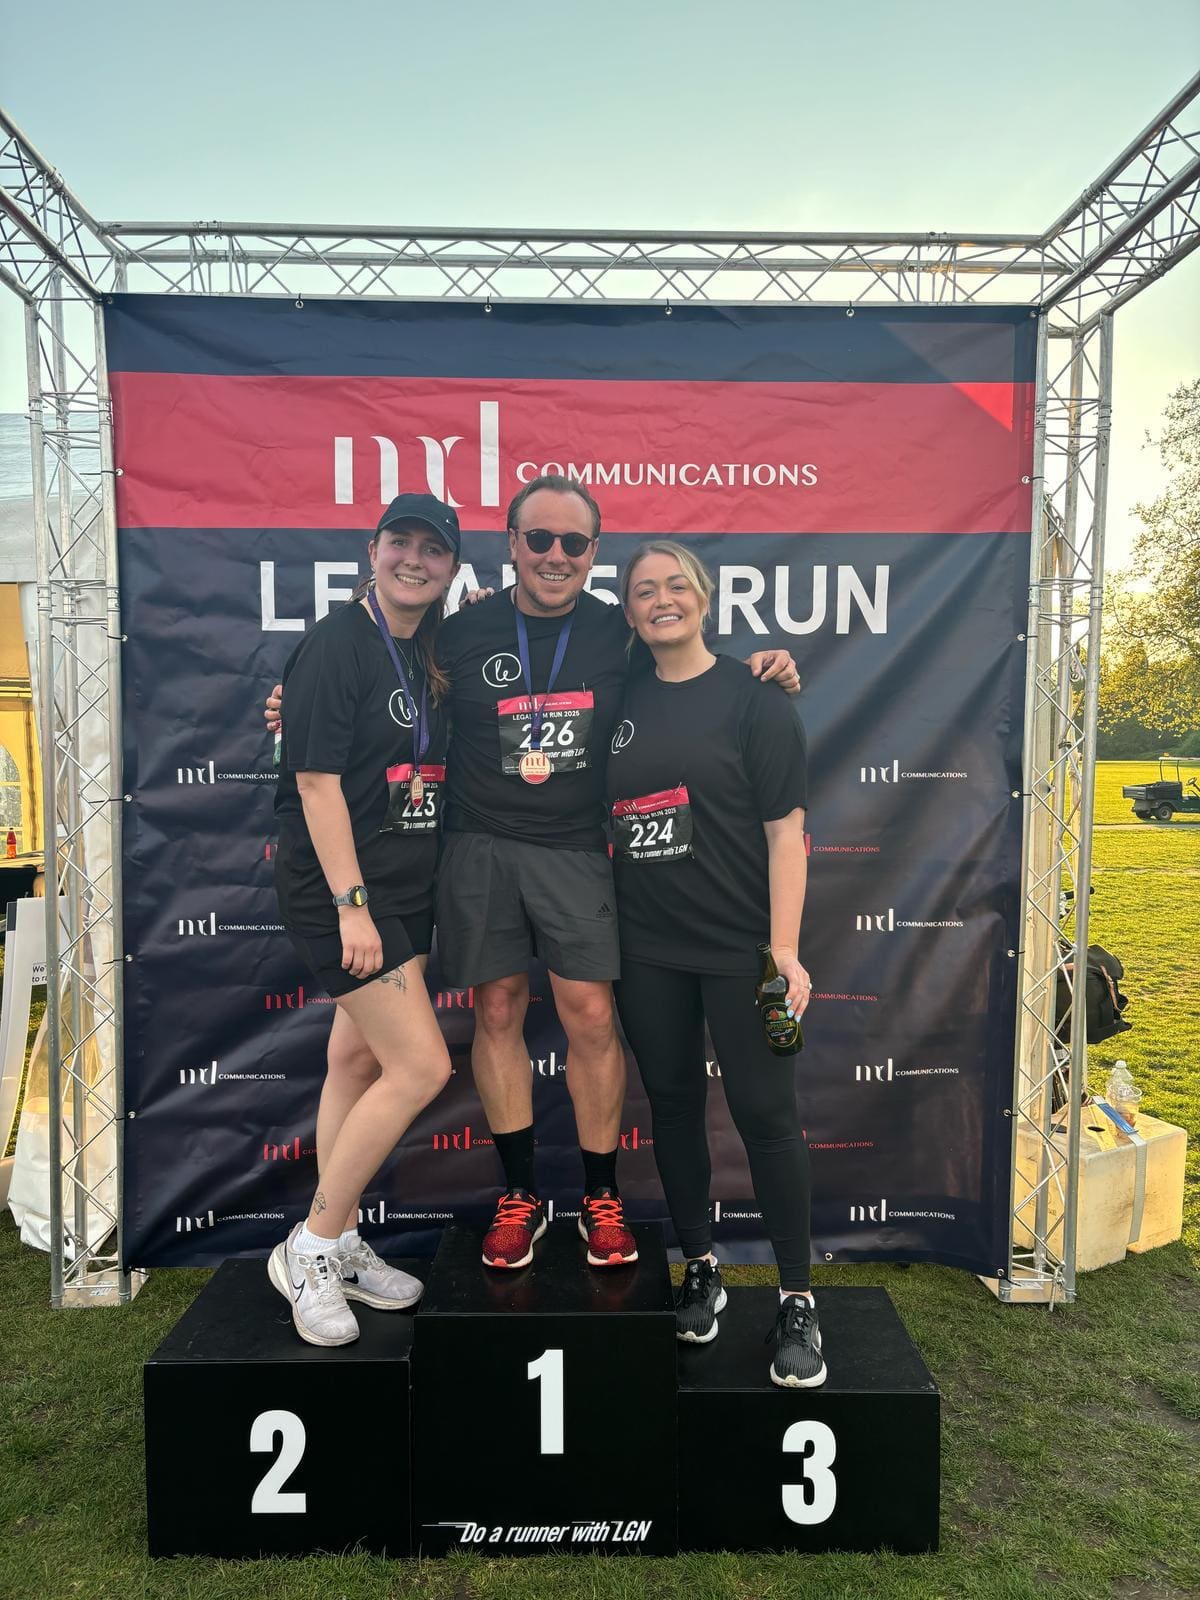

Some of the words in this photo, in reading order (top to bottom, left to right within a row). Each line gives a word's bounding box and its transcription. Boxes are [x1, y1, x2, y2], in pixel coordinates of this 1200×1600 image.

[516, 461, 818, 486] COMMUNICATIONS
[260, 561, 516, 632] LEA
[718, 564, 890, 635] RUN
[519, 721, 574, 748] 226
[629, 818, 674, 848] 224
[810, 993, 878, 1001] COMMUNICATIONS
[896, 1067, 960, 1076] COMMUNICATIONS
[808, 1141, 874, 1149] COMMUNICATIONS
[216, 1213, 285, 1222] COMMUNICATIONS
[888, 1211, 956, 1220] COMMUNICATIONS
[527, 1349, 564, 1455] 1
[249, 1410, 307, 1514] 2
[781, 1420, 837, 1526] 3
[456, 1522, 486, 1543] Do
[488, 1526, 503, 1543] a
[504, 1526, 569, 1543] runner
[571, 1521, 610, 1542] with
[611, 1520, 652, 1542] LGN
